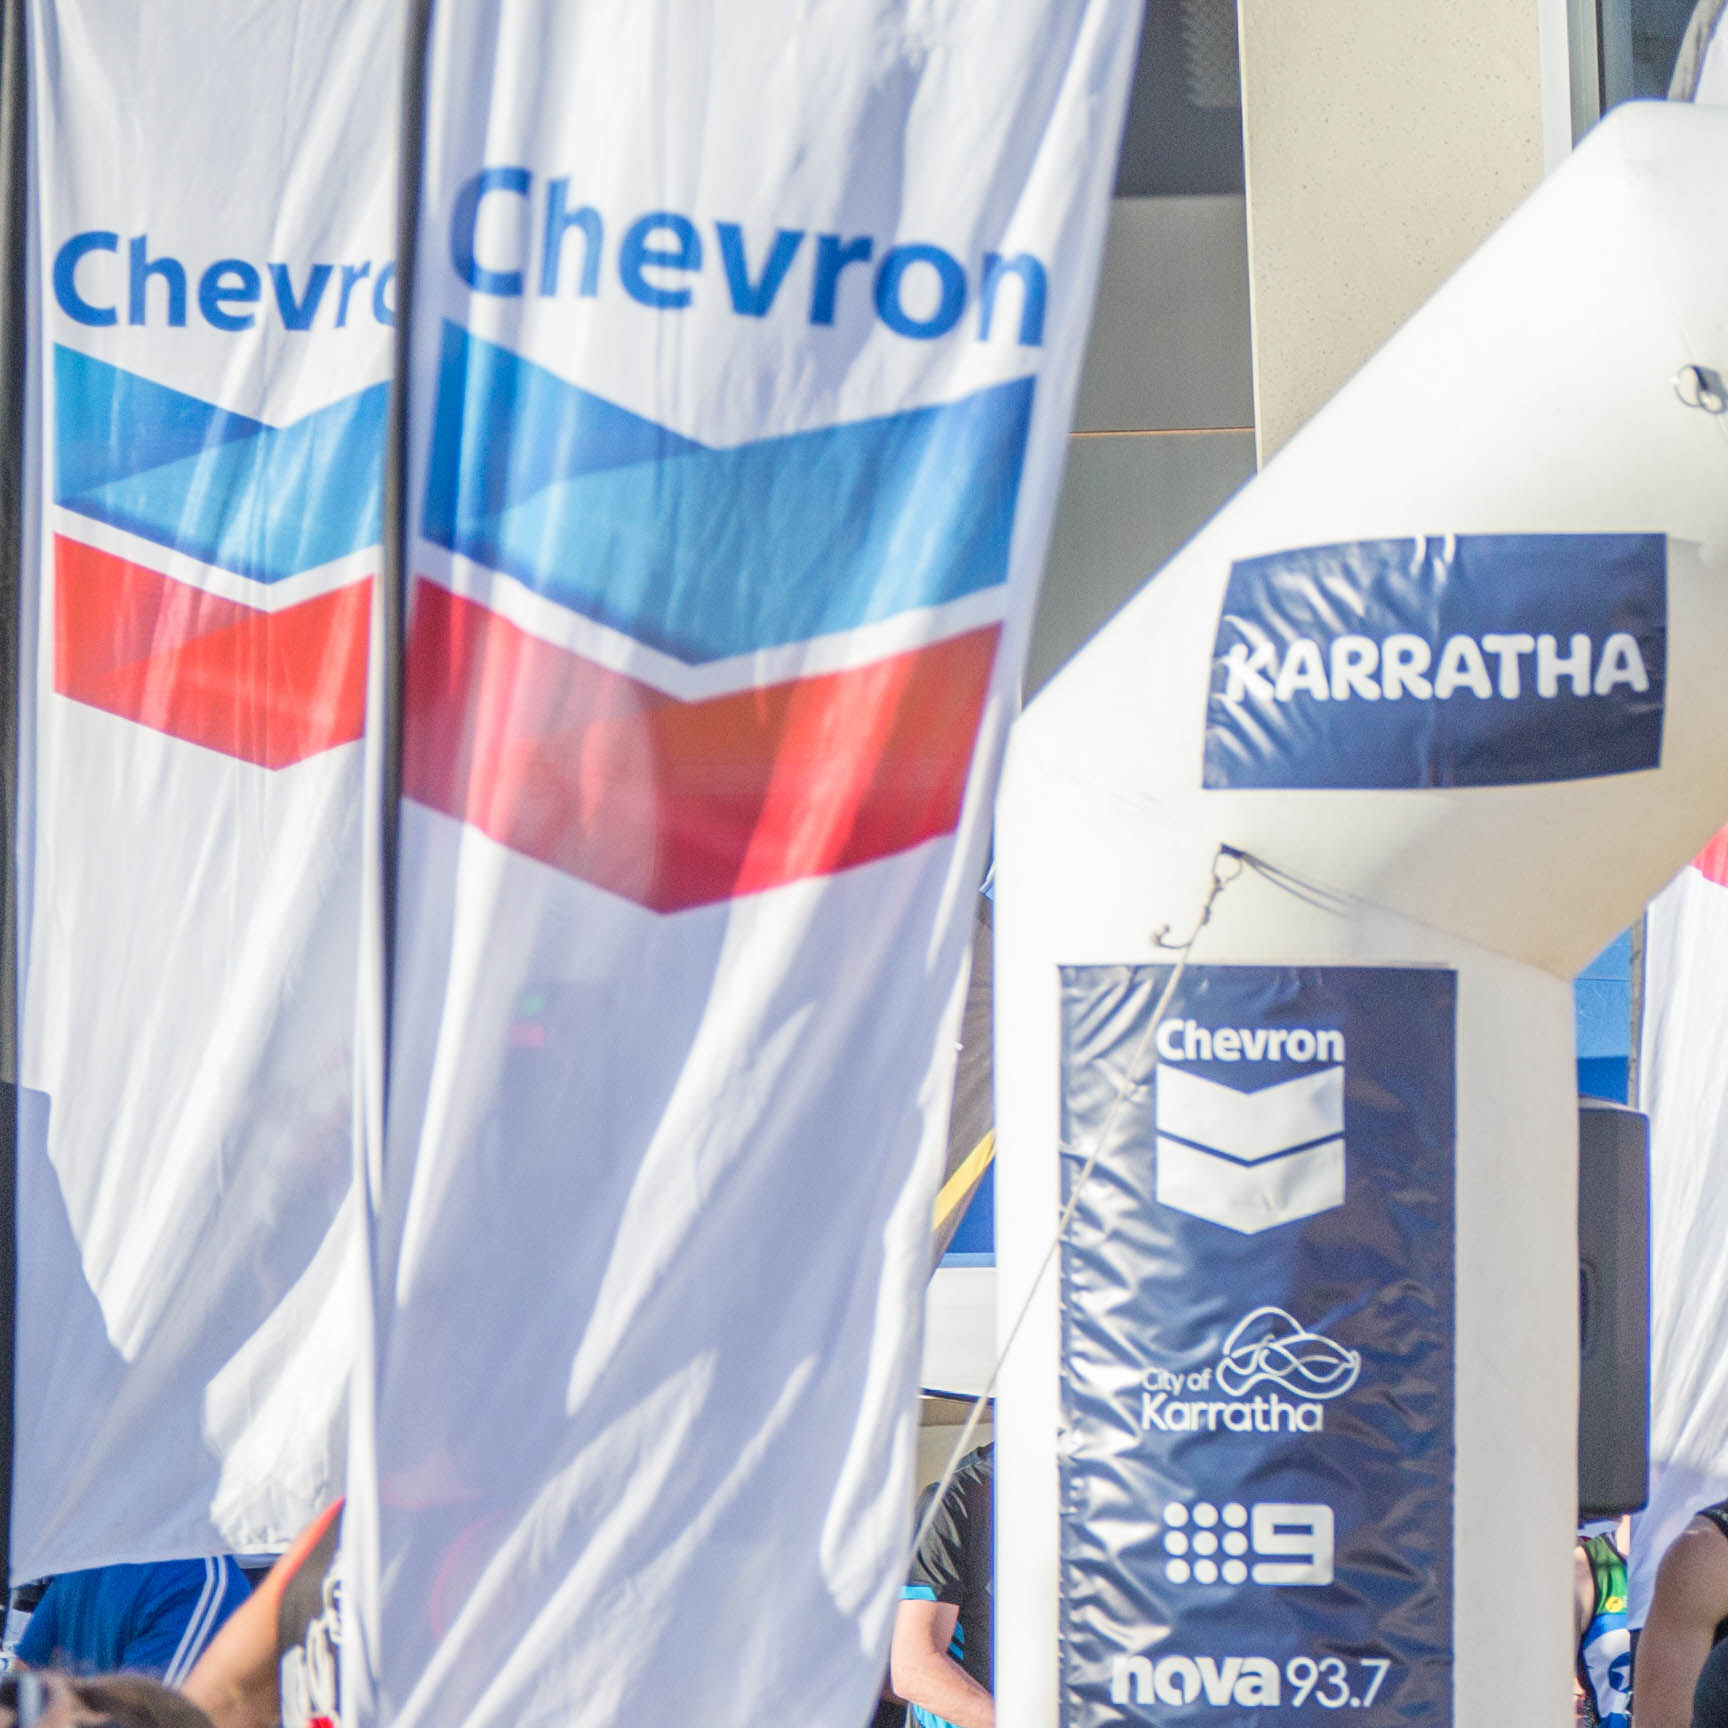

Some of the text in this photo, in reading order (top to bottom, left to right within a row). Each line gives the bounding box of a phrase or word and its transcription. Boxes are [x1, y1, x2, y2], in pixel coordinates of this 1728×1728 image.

[52, 231, 397, 332] Chevr
[448, 166, 1048, 348] Chevron
[1224, 633, 1650, 702] KARRATHA
[1156, 1019, 1346, 1062] Chevron
[1142, 1367, 1213, 1396] City of
[1142, 1394, 1324, 1432] Karratha
[1111, 1655, 1391, 1708] nova 93.7
